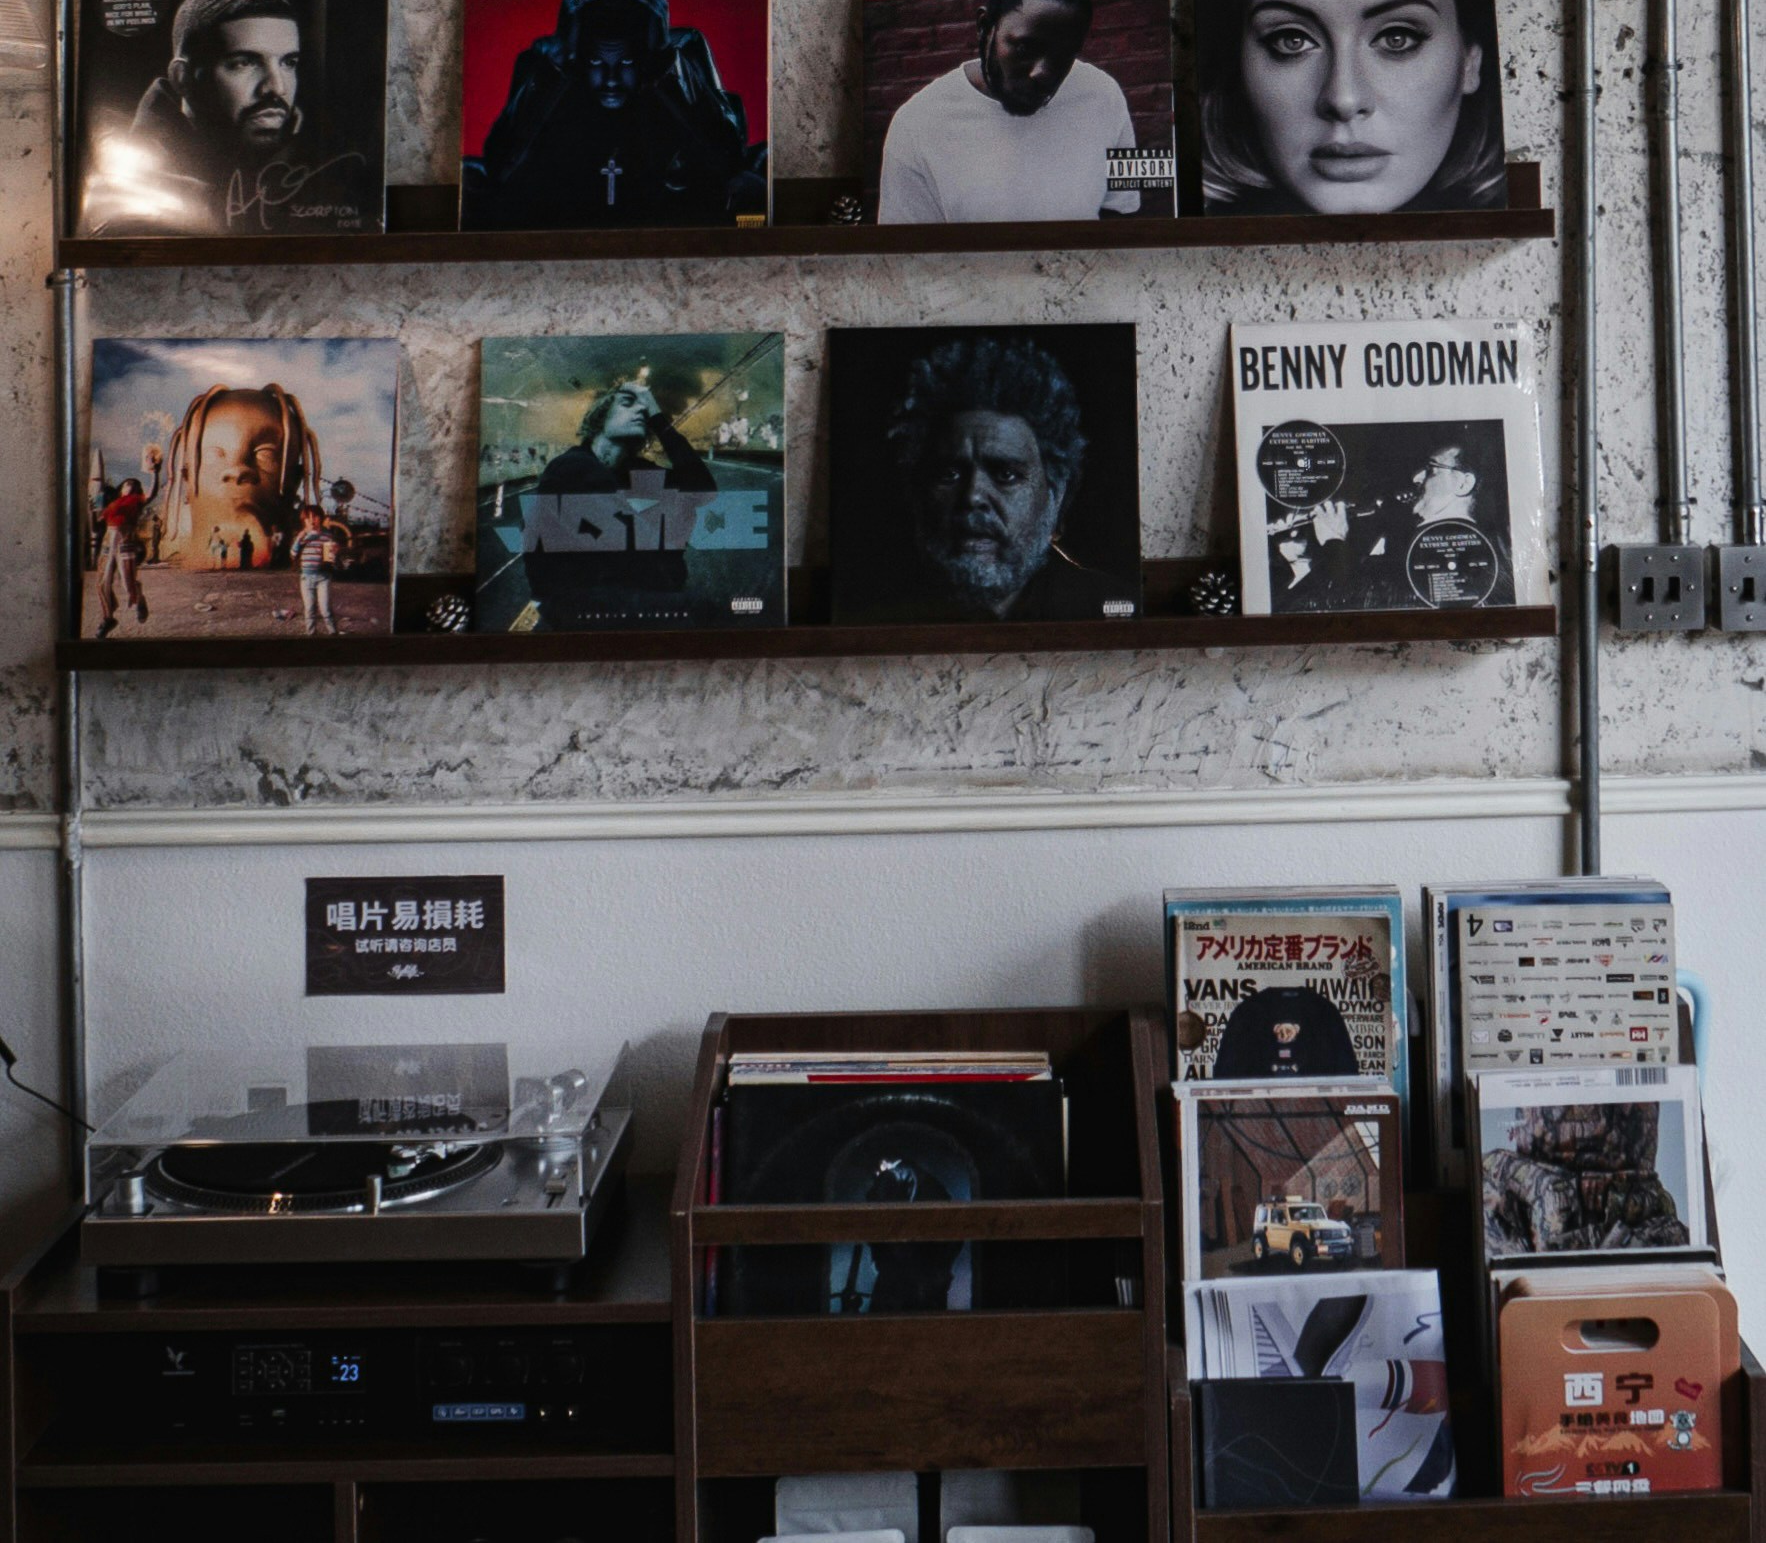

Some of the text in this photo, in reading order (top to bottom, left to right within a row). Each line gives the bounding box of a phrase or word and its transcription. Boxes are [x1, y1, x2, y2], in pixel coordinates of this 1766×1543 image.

[1109, 149, 1172, 158] PARENTAL
[1109, 160, 1173, 176] ADVISORY
[1110, 178, 1173, 188] EXPLICIT CONTENT
[1240, 340, 1518, 391] BENNY GOODMAN
[493, 469, 768, 554] JUSTICE
[326, 899, 486, 931] 唱片易損耗
[1467, 913, 1484, 938] 4
[355, 937, 458, 953] 试听请咨询店员
[1196, 934, 1373, 961] アメリカ定番ブランド
[1237, 961, 1292, 971] AMERICAN
[1295, 961, 1333, 970] BRAND
[1184, 978, 1257, 1001] VANS
[1339, 1000, 1385, 1013] DYMO
[340, 1364, 360, 1381] 23
[1564, 1372, 1654, 1406] 西宁
